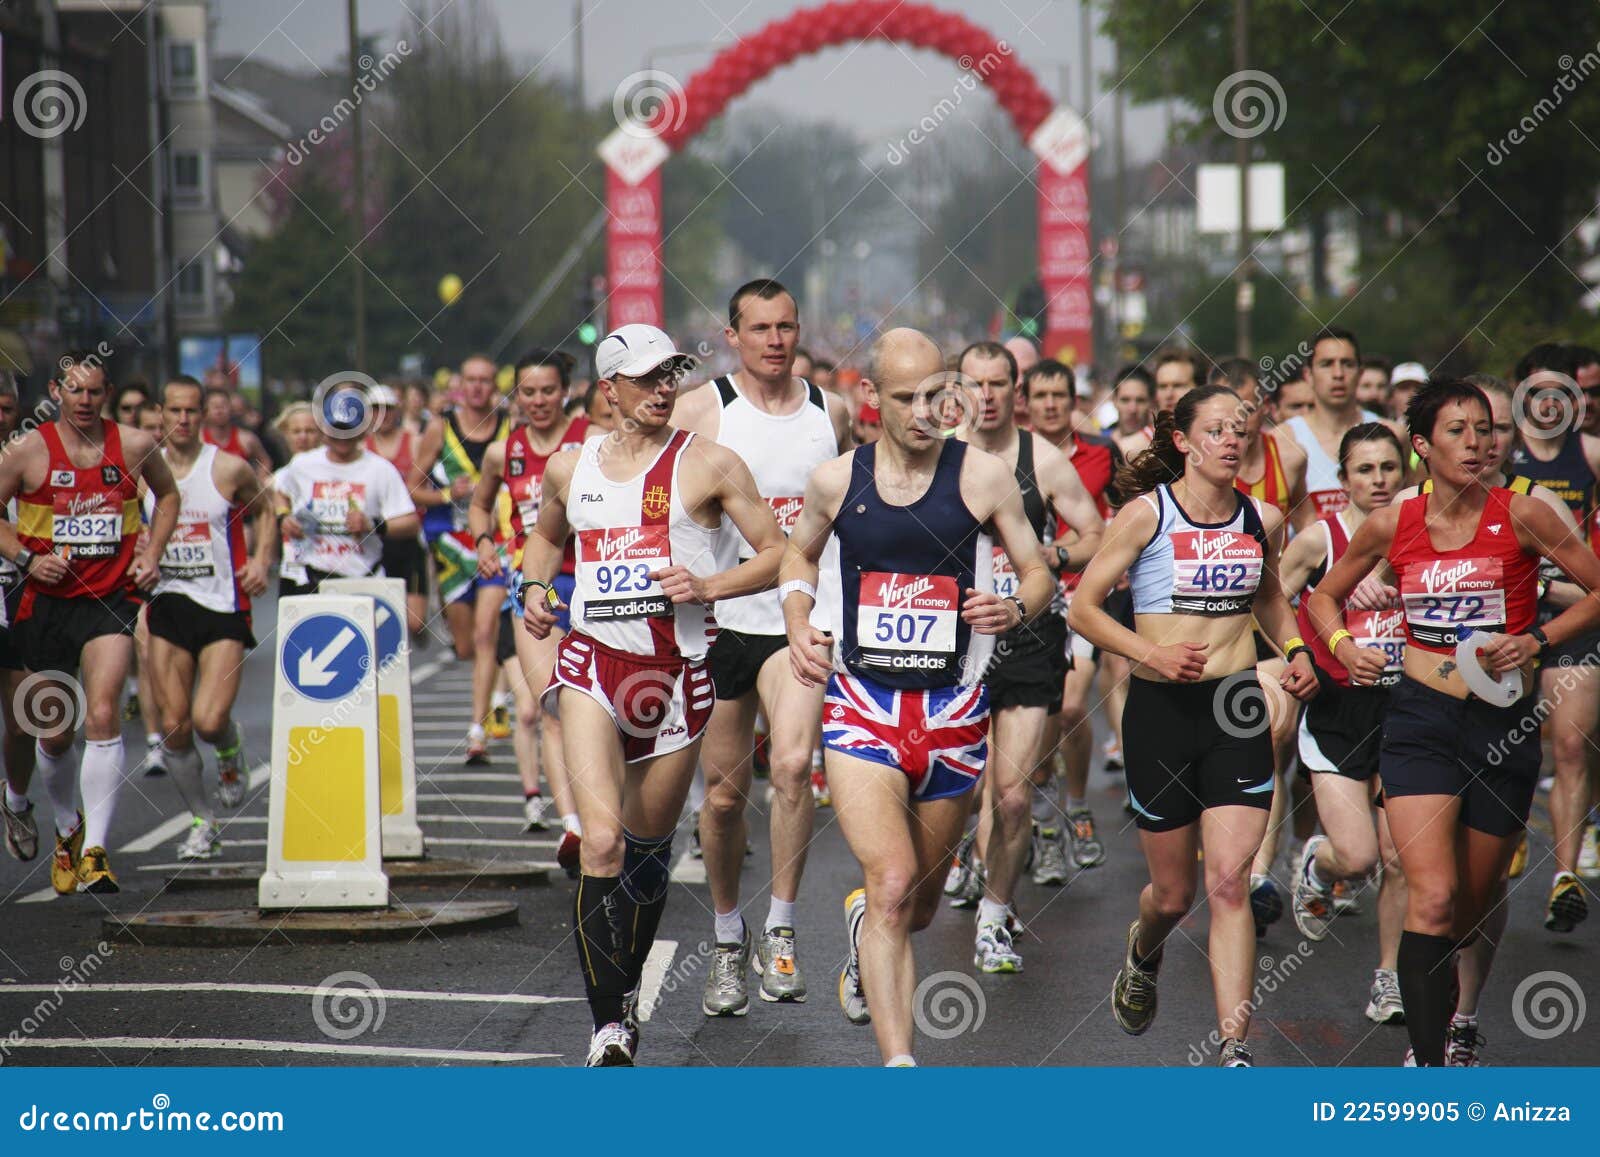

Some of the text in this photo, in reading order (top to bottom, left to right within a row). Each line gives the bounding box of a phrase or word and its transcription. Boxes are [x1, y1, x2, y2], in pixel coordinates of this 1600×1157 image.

[580, 494, 604, 503] FILA
[54, 517, 117, 537] 26321
[596, 528, 645, 561] Virgin
[627, 547, 662, 558] money
[1191, 531, 1239, 560] Virgin
[1224, 548, 1256, 557] money
[596, 564, 652, 593] 923
[1191, 563, 1247, 592] 462
[1420, 560, 1478, 595] Virgin
[1459, 580, 1496, 589] money
[878, 573, 935, 610] Virgin
[614, 600, 665, 616] adidas
[914, 598, 951, 610] money
[1422, 595, 1486, 622] 272
[874, 612, 938, 644] 507
[892, 654, 947, 669] adidas
[660, 726, 686, 738] FILA
